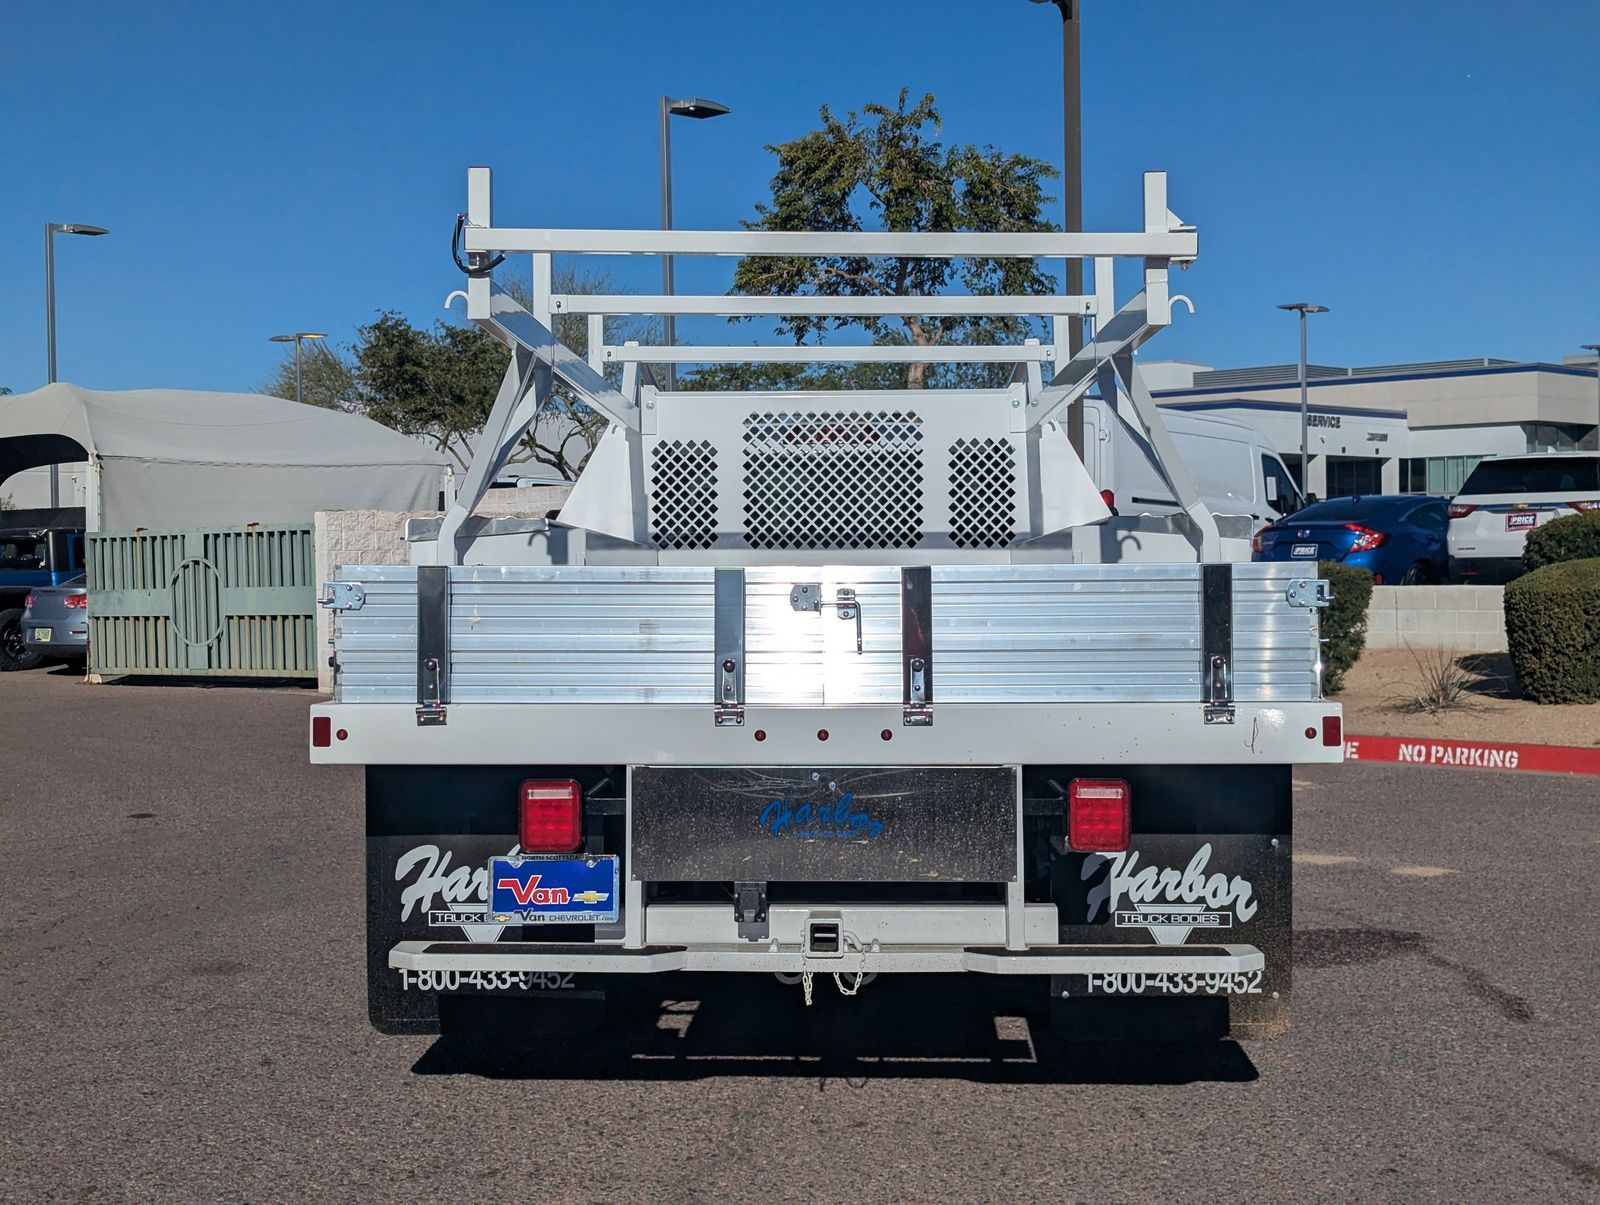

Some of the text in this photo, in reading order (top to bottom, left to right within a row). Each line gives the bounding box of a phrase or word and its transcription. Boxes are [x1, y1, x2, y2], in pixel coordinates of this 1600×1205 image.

[1307, 414, 1341, 429] SERVICE
[1511, 515, 1535, 525] PRICE
[1399, 743, 1519, 769] NO PARKING
[759, 792, 886, 837] Harbor
[396, 844, 521, 922] Har
[497, 875, 571, 905] Van
[1081, 842, 1258, 923] Harbor
[436, 913, 481, 922] TRUCK
[513, 908, 546, 922] Van
[1122, 913, 1220, 924] TRUCK BODIES
[399, 969, 576, 991] 1-800-433-9452
[1086, 971, 1263, 994] 1-800-433-9452
